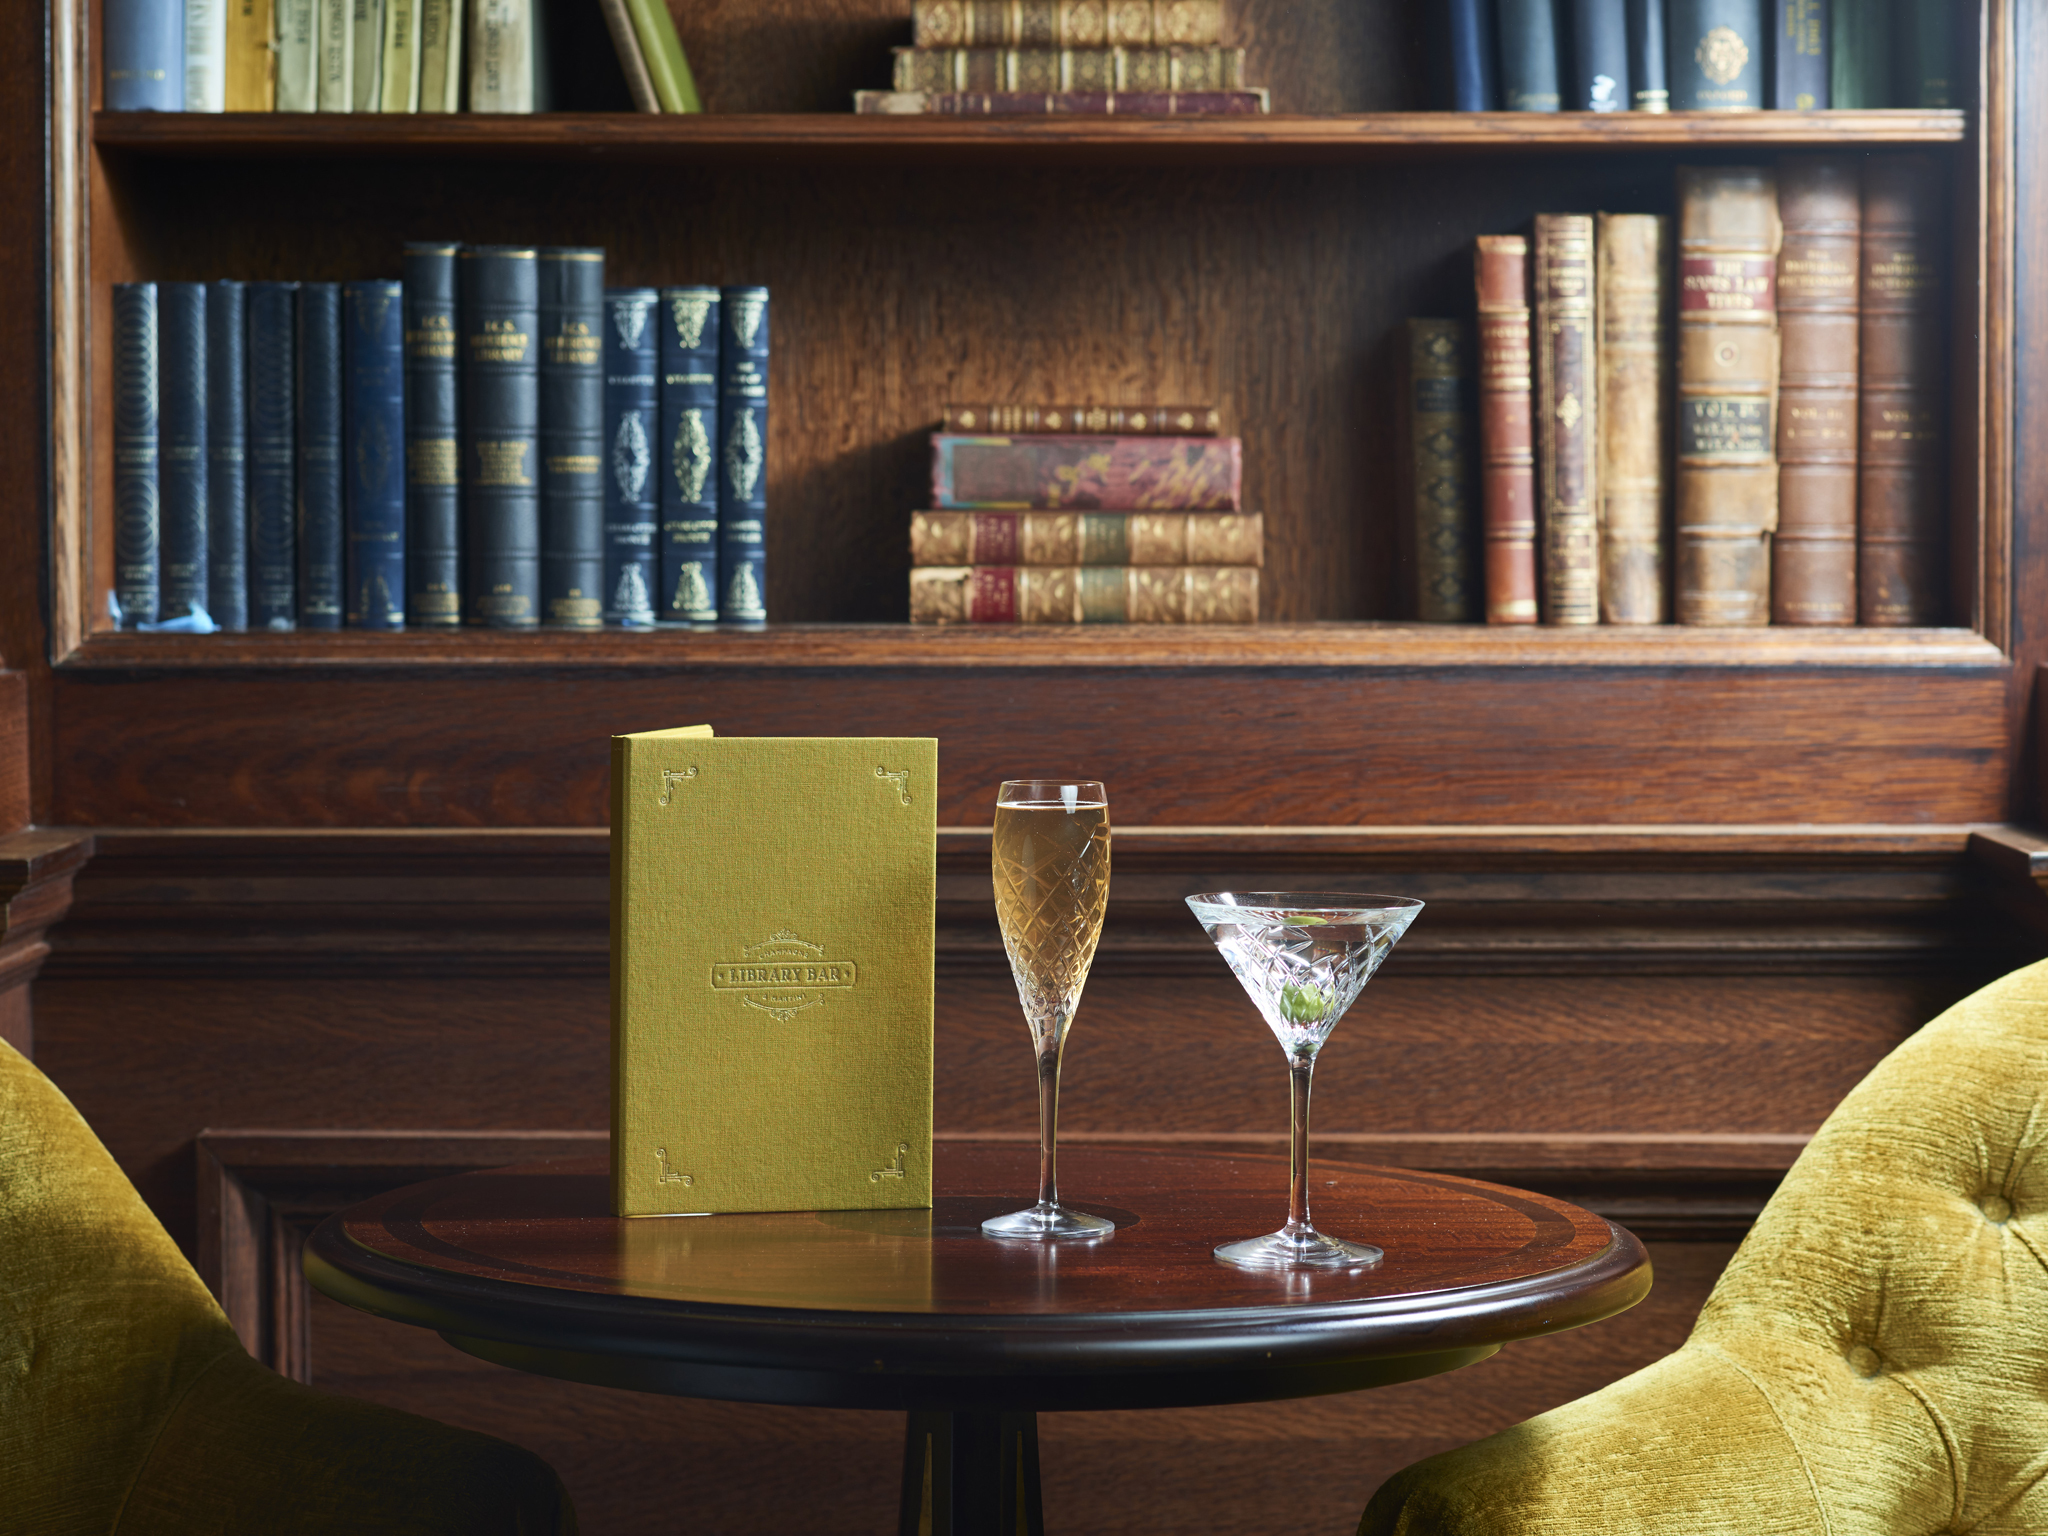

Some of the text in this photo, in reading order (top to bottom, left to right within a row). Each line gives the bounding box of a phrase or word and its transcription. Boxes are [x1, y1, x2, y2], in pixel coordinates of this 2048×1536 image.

[759, 949, 809, 959] CHAMPAGNE
[729, 968, 840, 983] LIBRARY BAR
[771, 993, 806, 1002] MARTINI
